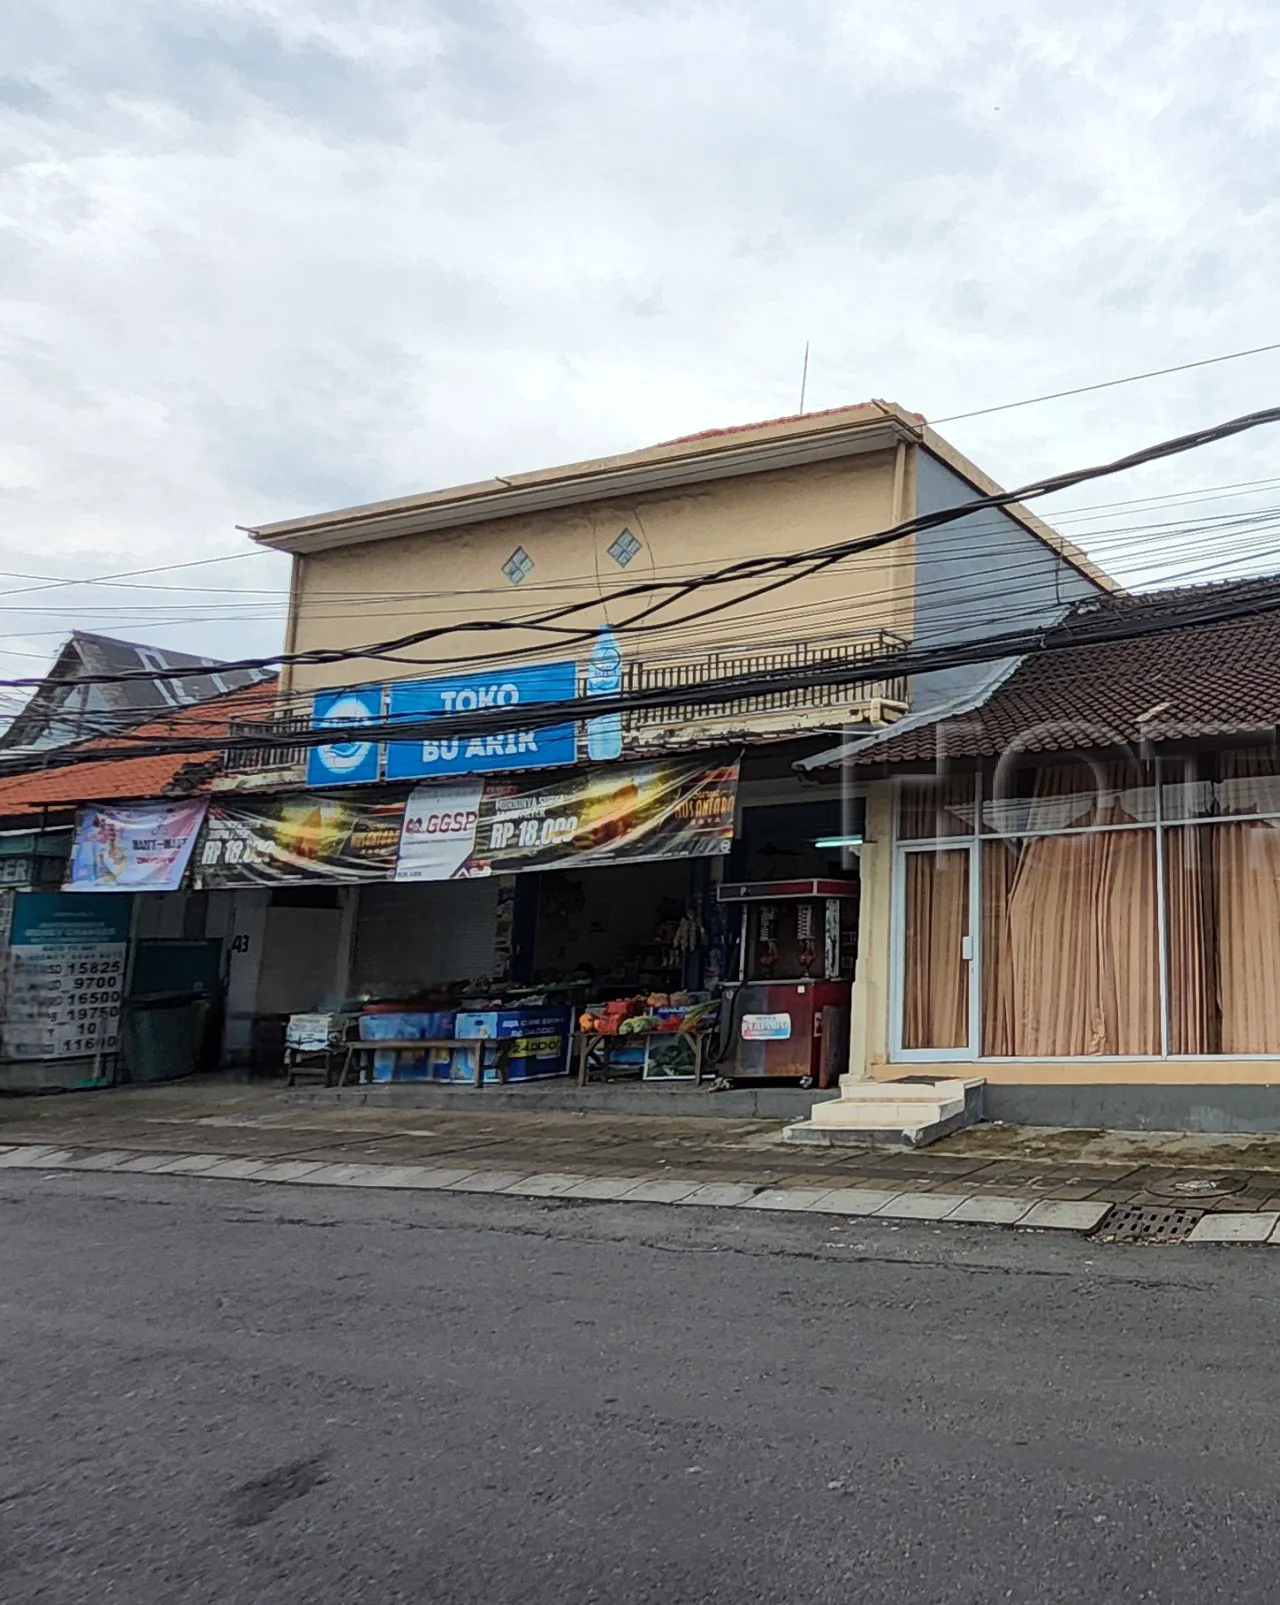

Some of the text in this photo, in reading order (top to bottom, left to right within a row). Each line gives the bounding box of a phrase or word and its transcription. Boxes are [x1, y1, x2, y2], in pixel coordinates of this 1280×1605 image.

[441, 683, 519, 711] TOKO
[423, 739, 459, 763] BU
[426, 811, 478, 834] GGSP
[490, 816, 578, 849] RP 18.000
[202, 841, 221, 864] RP
[231, 934, 250, 953] 43
[67, 961, 120, 975] 15825
[74, 976, 116, 990] 9700
[67, 991, 120, 1005] 16500
[67, 1006, 119, 1020] 19750
[77, 1022, 97, 1035] 10
